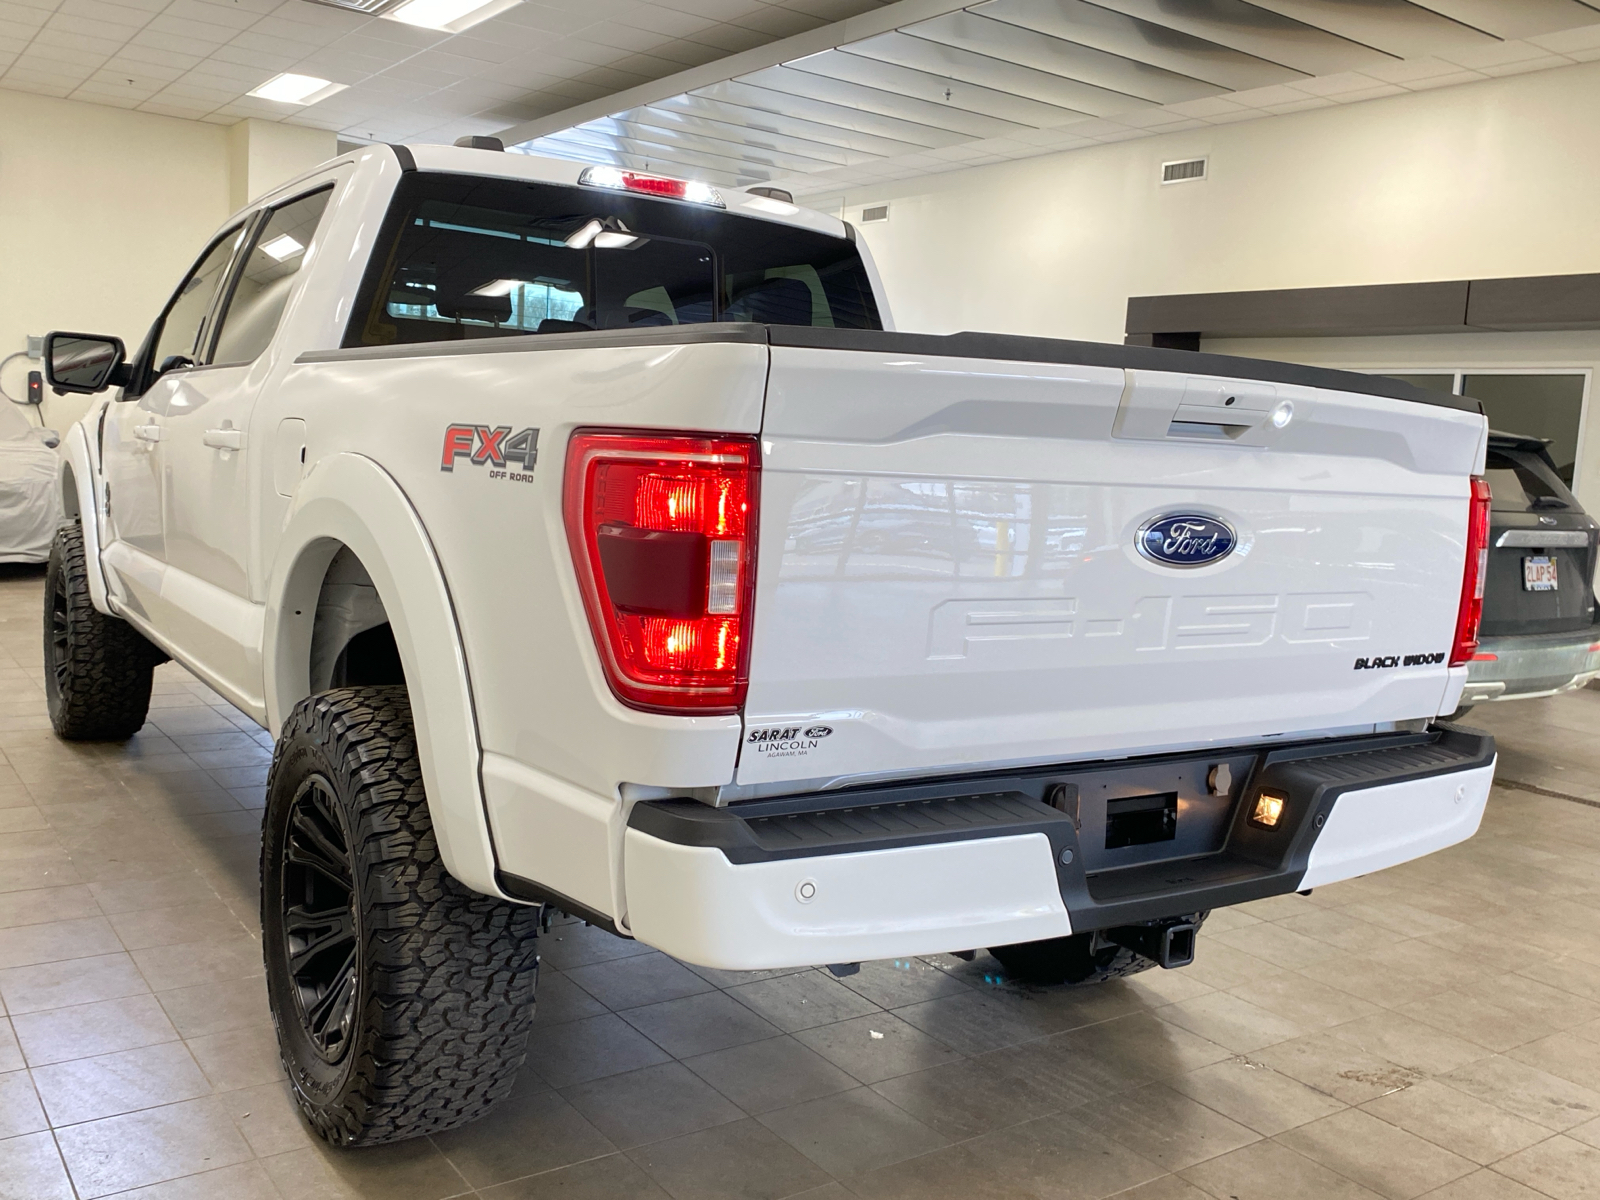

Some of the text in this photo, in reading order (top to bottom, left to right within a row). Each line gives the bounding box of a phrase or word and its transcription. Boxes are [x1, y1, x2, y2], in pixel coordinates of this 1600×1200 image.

[440, 423, 540, 472] FX4
[489, 470, 534, 483] OFF ROAD
[1163, 521, 1218, 555] Ford
[1526, 565, 1545, 582] 2LAP
[926, 590, 1374, 660] F-150
[1353, 652, 1445, 670] BLACK WIDOW
[747, 727, 801, 743] SARAT
[758, 740, 818, 752] LINCOLN
